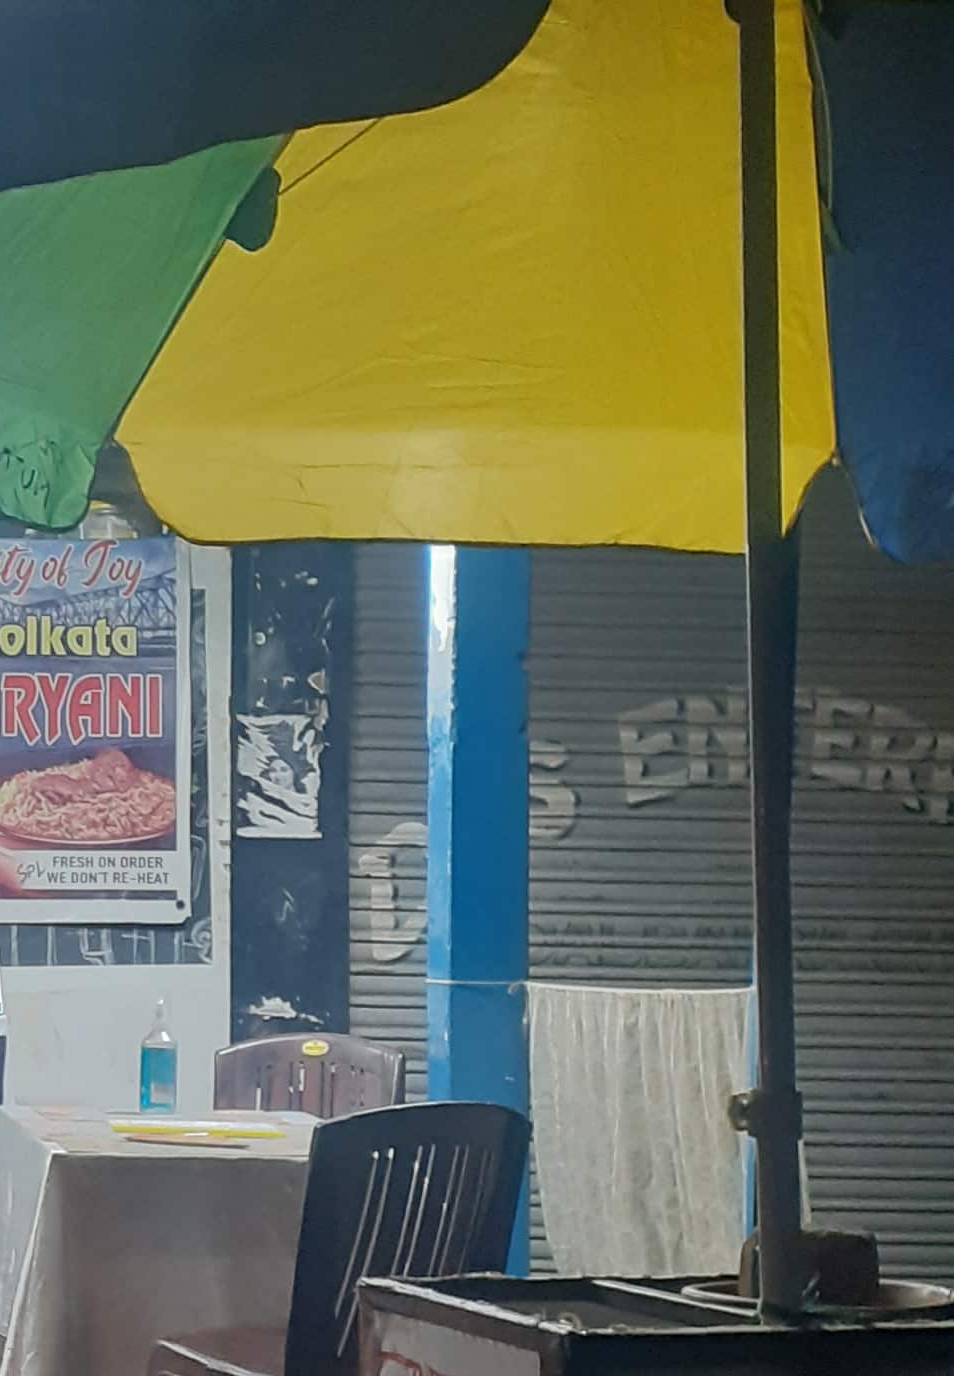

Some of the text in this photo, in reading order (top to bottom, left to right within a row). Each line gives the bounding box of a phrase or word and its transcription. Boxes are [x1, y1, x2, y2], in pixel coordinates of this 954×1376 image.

[40, 543, 69, 590] of
[82, 538, 143, 598] Joy
[52, 856, 164, 869] FRESH ON ORDER
[46, 872, 170, 885] WE DON'T RE-HEAT
